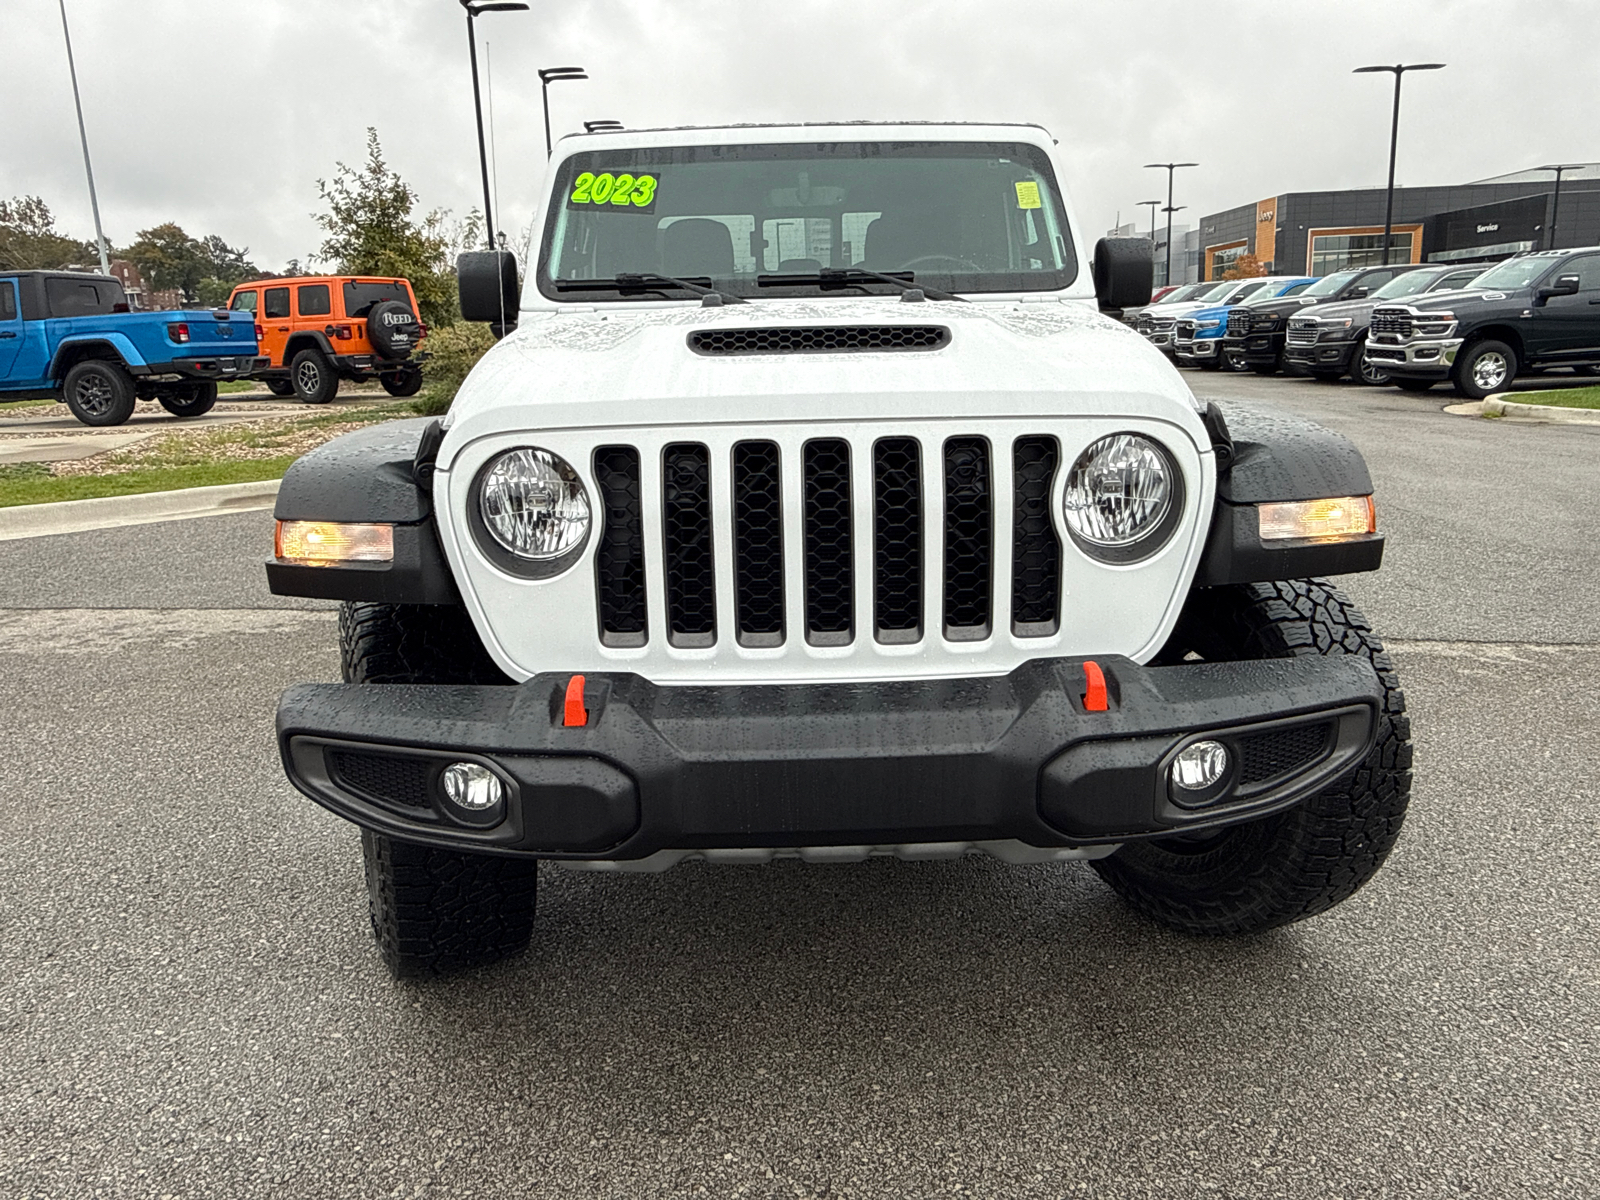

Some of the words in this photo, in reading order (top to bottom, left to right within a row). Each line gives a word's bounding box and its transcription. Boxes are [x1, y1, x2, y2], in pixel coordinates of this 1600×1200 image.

[571, 172, 657, 207] 2023
[1476, 223, 1499, 234] Service
[382, 312, 412, 327] REED
[390, 332, 409, 342] Jeep
